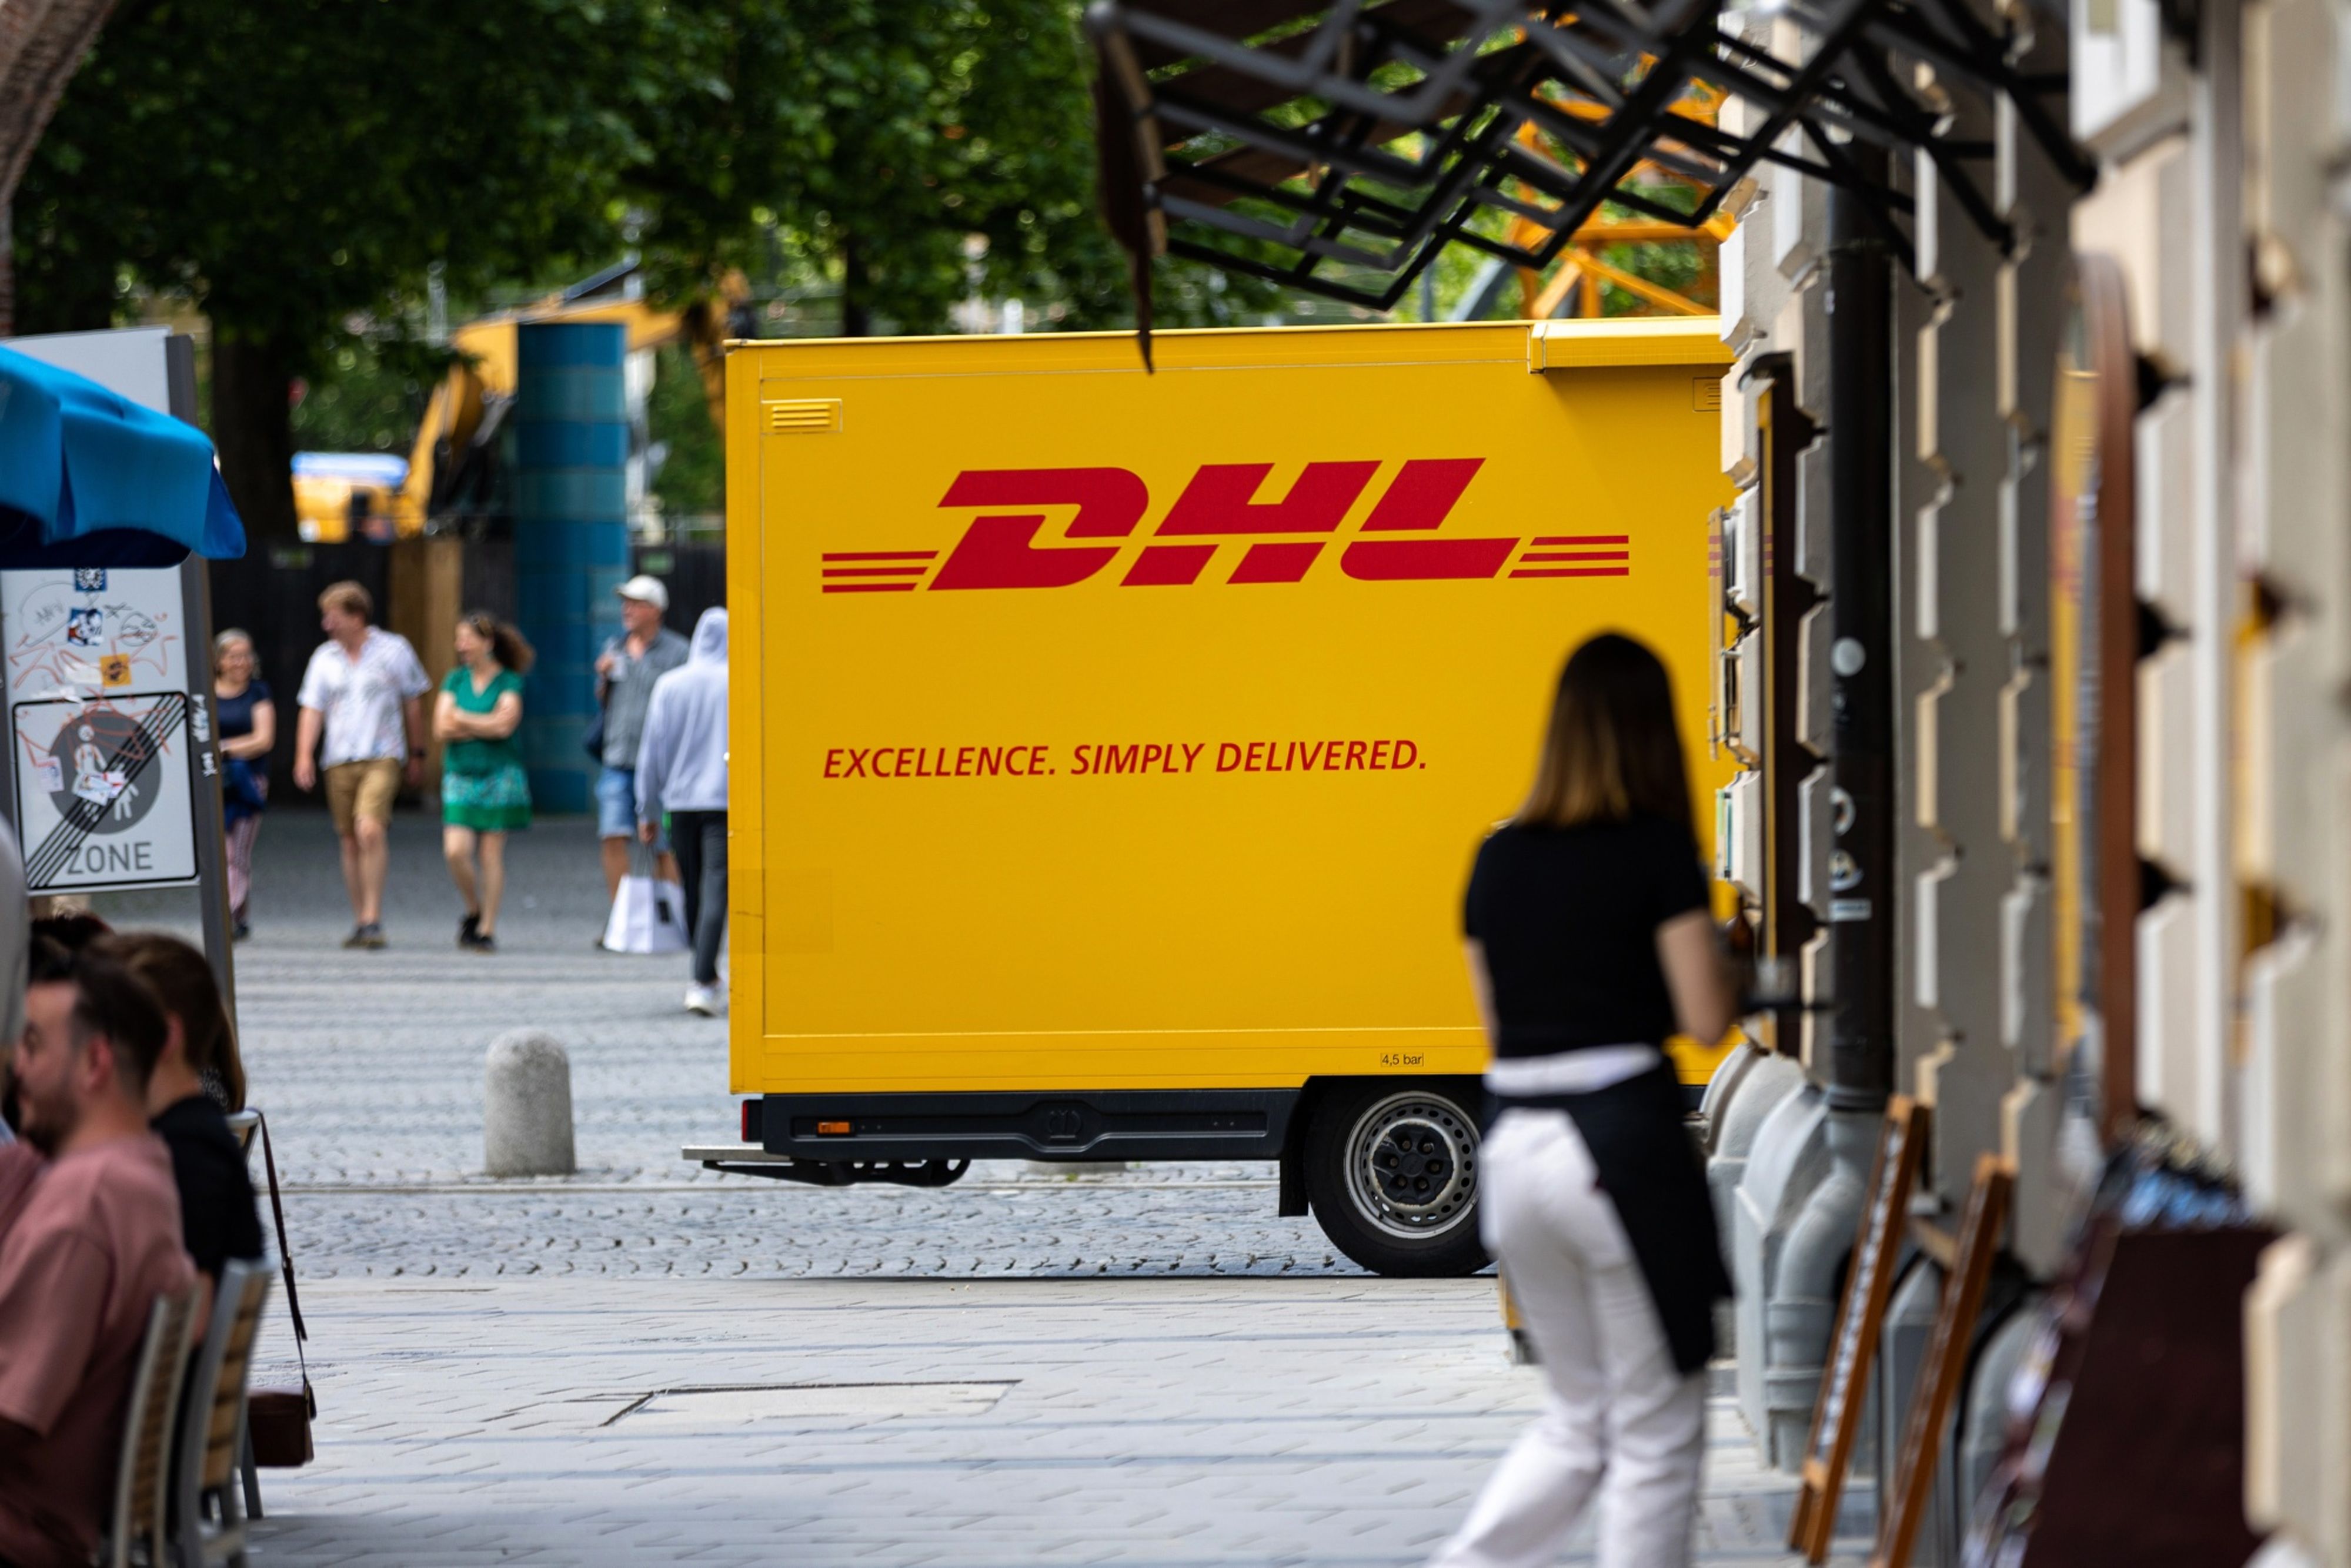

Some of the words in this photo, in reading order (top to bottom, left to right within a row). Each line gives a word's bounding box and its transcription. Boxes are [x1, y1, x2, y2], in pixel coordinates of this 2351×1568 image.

[927, 457, 1522, 592] DHL
[823, 745, 1056, 778] EXCELLENCE.
[1070, 743, 1205, 775] SIMPLY
[1215, 740, 1426, 773] DELIVERED.
[66, 841, 153, 875] ZONE
[1382, 1054, 1400, 1066] 4,5
[1403, 1054, 1422, 1065] bar
